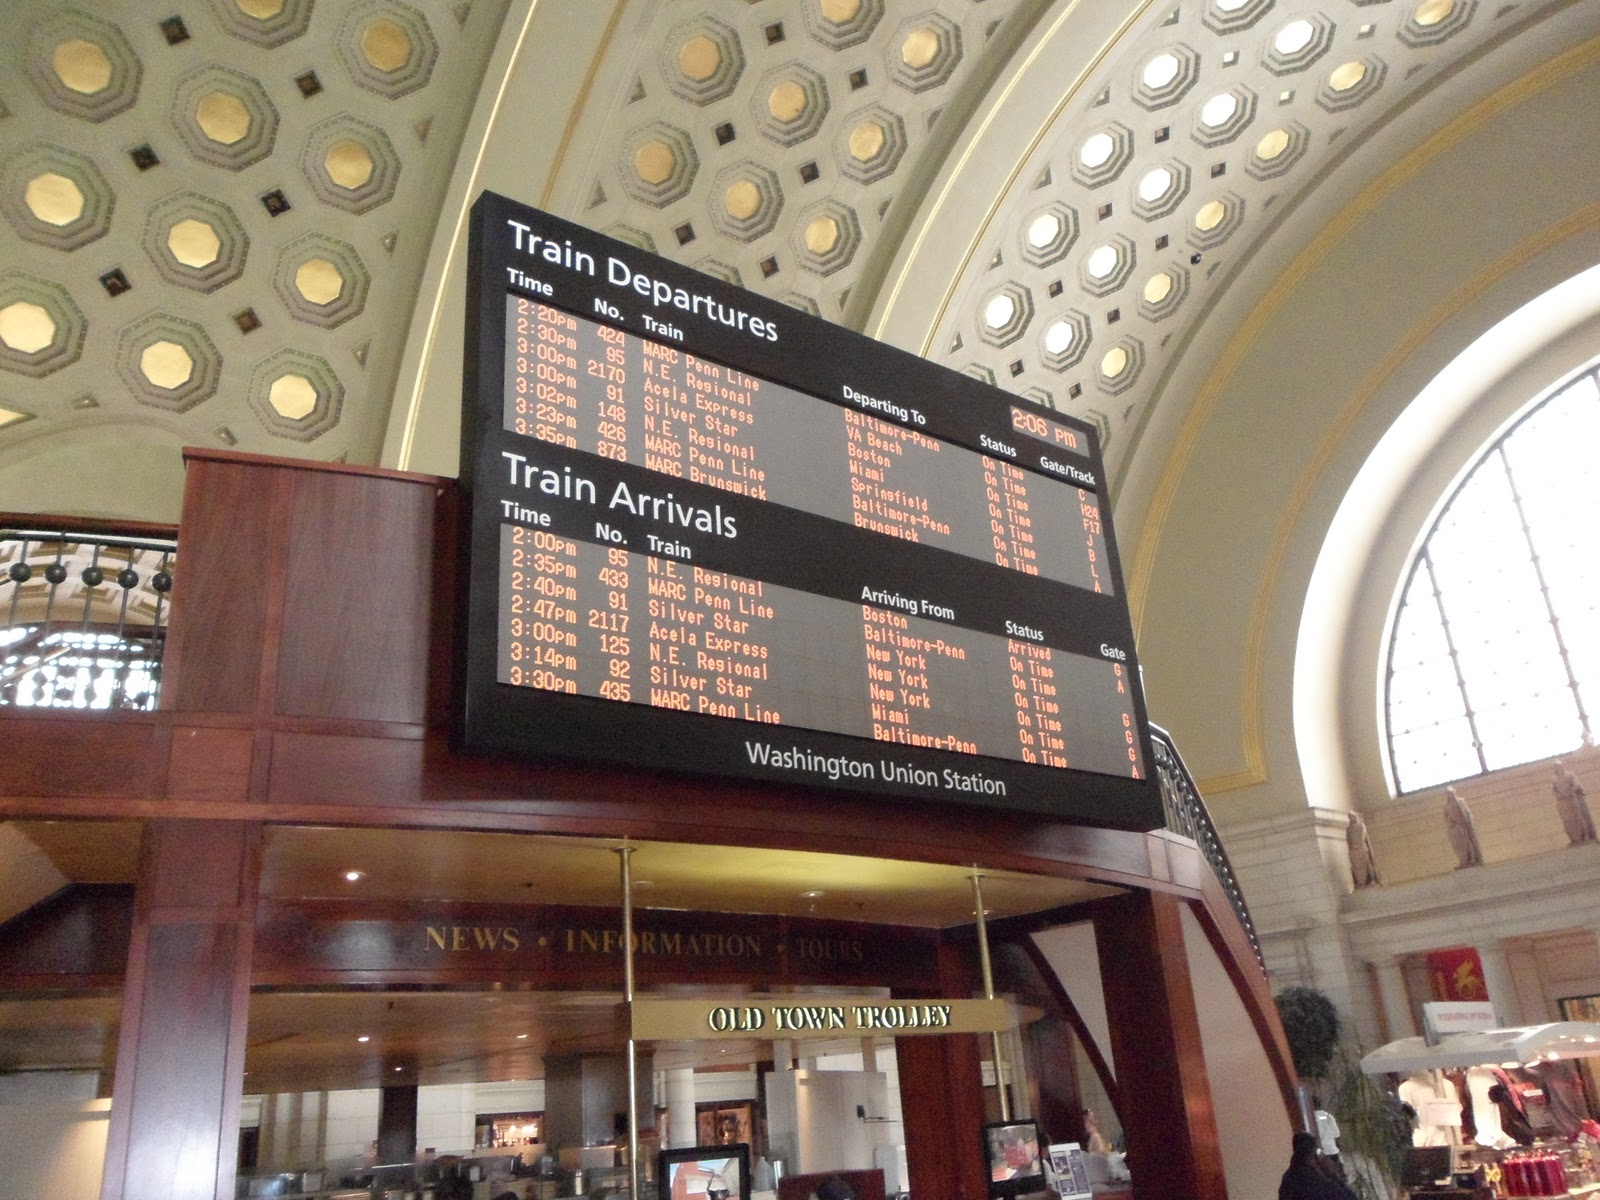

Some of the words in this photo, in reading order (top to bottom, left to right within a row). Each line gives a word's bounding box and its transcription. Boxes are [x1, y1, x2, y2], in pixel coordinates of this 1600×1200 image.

[506, 266, 554, 297] Time
[507, 219, 595, 276] Train
[608, 256, 778, 342] Departures
[517, 298, 578, 332] 2:20pm
[594, 297, 625, 321] No.
[516, 317, 578, 351] 2:30pm
[596, 325, 626, 348] 424
[641, 314, 684, 342] Train
[517, 336, 578, 370] 3:00pm
[605, 345, 626, 366] 95
[642, 339, 679, 365] MARC
[685, 354, 720, 379] Penn
[726, 368, 760, 392] Line
[516, 356, 577, 390] 3:00pm
[587, 358, 626, 385] 2170
[642, 357, 677, 383] N.E.
[686, 371, 752, 407] Regional
[515, 376, 577, 409] 3:02pm
[606, 384, 625, 404] 91
[643, 376, 688, 405] Acela
[695, 392, 754, 425] Express
[842, 385, 909, 423] Departing
[910, 408, 927, 425] To
[515, 396, 577, 430] 3:23pm
[598, 400, 627, 423] 148
[643, 395, 697, 425] Silver
[704, 414, 738, 438] Star
[515, 417, 577, 449] 3:35pm
[597, 420, 627, 443] 426
[644, 414, 678, 439] N.E.
[688, 427, 755, 461] Regional
[844, 408, 940, 453] Baltimore-Penn
[845, 424, 863, 443] VA
[866, 431, 903, 456] Beach
[1011, 408, 1049, 437] 2:06
[1054, 427, 1077, 449] pm
[597, 439, 627, 462] 873
[644, 433, 682, 459] MARC
[688, 446, 724, 471] Penn
[731, 458, 765, 482] Line
[847, 441, 891, 468] Boston
[979, 433, 1017, 458] Status
[645, 452, 683, 478] MARC
[689, 465, 767, 501] Brunswick
[848, 458, 885, 483] Miami
[981, 455, 996, 472] On
[999, 461, 1025, 481] Time
[1039, 455, 1096, 486] Gate/Track
[501, 450, 596, 505] Train
[608, 481, 738, 539] Arrivals
[850, 476, 929, 513] Springfield
[984, 470, 998, 488] On
[1001, 476, 1027, 497] Time
[1077, 488, 1086, 502] C
[986, 486, 1001, 503] On
[1003, 492, 1029, 512] Time
[500, 499, 551, 527] Time
[852, 493, 951, 535] Baltimore-Penn
[988, 502, 1003, 519] On
[1006, 508, 1032, 528] Time
[1082, 517, 1101, 535] F17
[595, 521, 628, 545] No.
[853, 511, 919, 543] Brunswick
[990, 518, 1005, 536] On
[1008, 524, 1034, 544] Time
[512, 526, 577, 557] 2:00pm
[646, 534, 692, 560] Train
[992, 535, 1007, 552] On
[1010, 540, 1037, 560] Time
[1086, 534, 1094, 548] J
[511, 548, 577, 579] 2:35pm
[607, 547, 629, 568] 95
[995, 551, 1010, 568] On
[1013, 556, 1039, 576] Time
[1087, 548, 1097, 563] B
[598, 566, 629, 590] 433
[647, 556, 683, 580] N.E.
[693, 566, 763, 597] Regional
[1090, 565, 1100, 578] L
[511, 570, 577, 601] 2:40pm
[647, 576, 687, 602] MARC
[694, 586, 731, 611] Penn
[738, 596, 774, 620] Line
[1094, 579, 1102, 593] A
[511, 593, 577, 624] 2:47pm
[608, 590, 629, 612] 91
[861, 585, 919, 615] Arriving
[921, 599, 955, 621] From
[588, 608, 630, 634] 2117
[648, 598, 705, 626] Silver
[713, 611, 749, 635] Star
[862, 604, 908, 630] Boston
[510, 617, 577, 648] 3:00pm
[649, 620, 697, 647] Acela
[705, 631, 768, 660] Express
[863, 623, 966, 660] Baltimore-Penn
[1005, 620, 1044, 642] Status
[510, 641, 577, 671] 3:14pm
[600, 633, 630, 657] 125
[865, 643, 891, 663] New
[895, 649, 927, 671] York
[1007, 638, 1052, 662] Arrived
[1100, 643, 1126, 661] Gate
[609, 658, 631, 680] 92
[649, 642, 686, 666] N.E.
[696, 650, 768, 680] Regional
[1009, 655, 1025, 673] On
[1027, 659, 1054, 679] Time
[1113, 662, 1122, 677] G
[510, 665, 577, 695] 3:30pm
[650, 665, 708, 692] Silver
[716, 676, 753, 699] Star
[867, 662, 893, 683] New
[897, 668, 929, 690] York
[1011, 673, 1027, 691] On
[1030, 677, 1057, 697] Time
[1116, 679, 1125, 694] A
[599, 680, 631, 702] 435
[869, 682, 895, 703] New
[899, 688, 931, 709] York
[1014, 691, 1029, 709] On
[1032, 695, 1060, 714] Time
[650, 687, 691, 711] MARC
[698, 695, 737, 718] Penn
[744, 702, 780, 725] Line
[871, 702, 910, 725] Miami
[1016, 709, 1032, 727] On
[1035, 713, 1062, 732] Time
[1121, 712, 1131, 728] G
[873, 722, 977, 755] Baltimore-Penn
[1019, 728, 1034, 746] On
[1037, 731, 1065, 750] Time
[1124, 729, 1134, 745] G
[1021, 746, 1037, 764] On
[1040, 749, 1068, 768] Time
[1127, 747, 1137, 762] G
[745, 741, 875, 780] Washington
[880, 760, 939, 787] Union
[943, 768, 1006, 796] Station
[1131, 764, 1140, 779] A
[424, 926, 520, 952] NEWS
[708, 1006, 766, 1031] OLD
[771, 1006, 846, 1031] TOWN
[852, 1005, 953, 1029] TROLLEY
